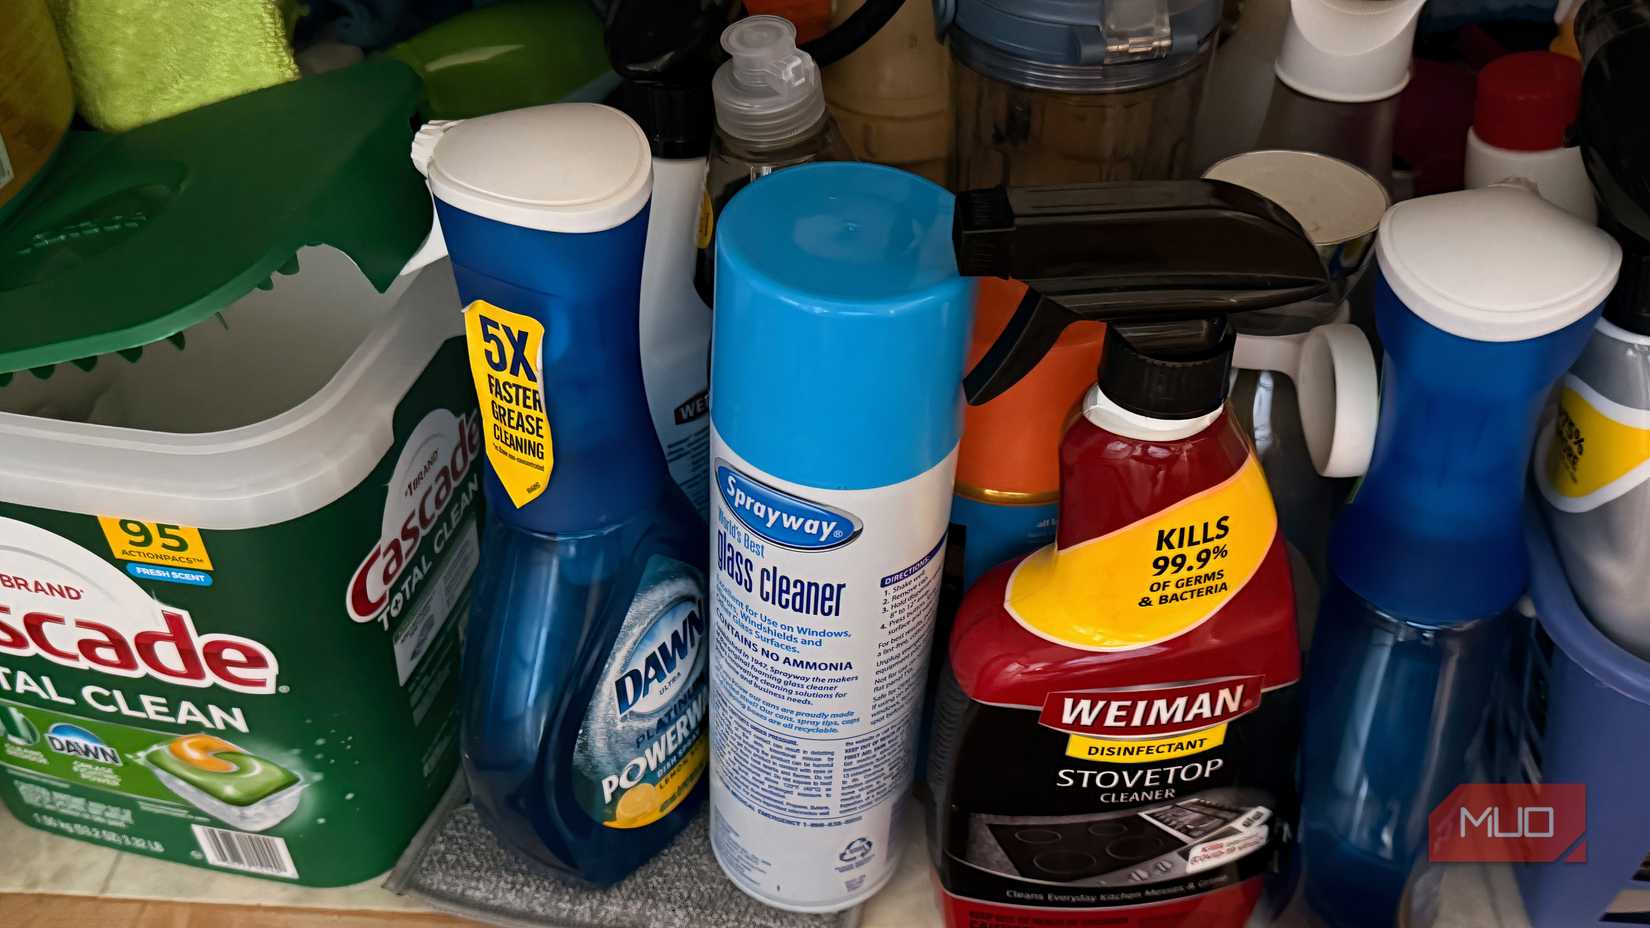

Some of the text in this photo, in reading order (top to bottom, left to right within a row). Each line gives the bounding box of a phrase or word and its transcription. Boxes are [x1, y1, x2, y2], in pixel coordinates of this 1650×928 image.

[479, 314, 537, 382] 5X
[487, 373, 543, 413] FASTER
[491, 399, 544, 438] GREASE
[493, 425, 544, 460] CLEANING
[118, 519, 189, 552] 95
[744, 533, 765, 559] Best
[1156, 515, 1230, 551] KILLS
[378, 556, 432, 631] TOTAL
[433, 473, 480, 554] CLEAN
[1152, 545, 1228, 577] 99.9%
[135, 566, 205, 582] FRESH SCENT
[718, 529, 753, 593] glass
[760, 566, 846, 617] cleaner
[893, 579, 913, 593] Shake
[1149, 569, 1225, 593] OF GERMS
[1138, 581, 1228, 608] & BACTERIA
[732, 615, 753, 636] Glass
[754, 630, 800, 654] Surfaces.
[740, 611, 798, 643] Windshields
[801, 636, 822, 647] and
[745, 604, 758, 617] for
[760, 613, 778, 628] Use
[780, 622, 794, 633] on
[797, 625, 851, 639] Windows,
[0, 605, 269, 688] scade
[716, 607, 758, 653] CONTAINS
[761, 647, 780, 662] NO
[782, 656, 853, 671] AMMONIA
[615, 610, 705, 715] DAWN
[751, 664, 782, 684] foaming
[783, 680, 804, 689] glass
[806, 683, 838, 691] cleaner
[769, 666, 810, 684] Sprayway
[812, 676, 826, 684] the
[827, 675, 859, 684] makers
[0, 665, 250, 733] TAL CLEAN
[659, 671, 681, 696] ULTRA
[754, 682, 785, 700] business
[786, 696, 813, 706] needs.
[760, 679, 793, 696] cleaning
[795, 689, 833, 699] solutions
[636, 680, 699, 748] PLATIN
[759, 705, 773, 716] Our
[781, 707, 795, 715] are
[795, 711, 829, 720] proudly
[49, 734, 120, 765] DAWN
[602, 684, 708, 804] POWERW
[1087, 737, 1208, 756] DISINFECTANT
[1056, 758, 1224, 788] STOVETOP
[1099, 788, 1176, 803] CLEANER
[1006, 889, 1044, 900] Cleans
[1047, 892, 1097, 903] Everyday
[1100, 890, 1142, 901] Kitchen
